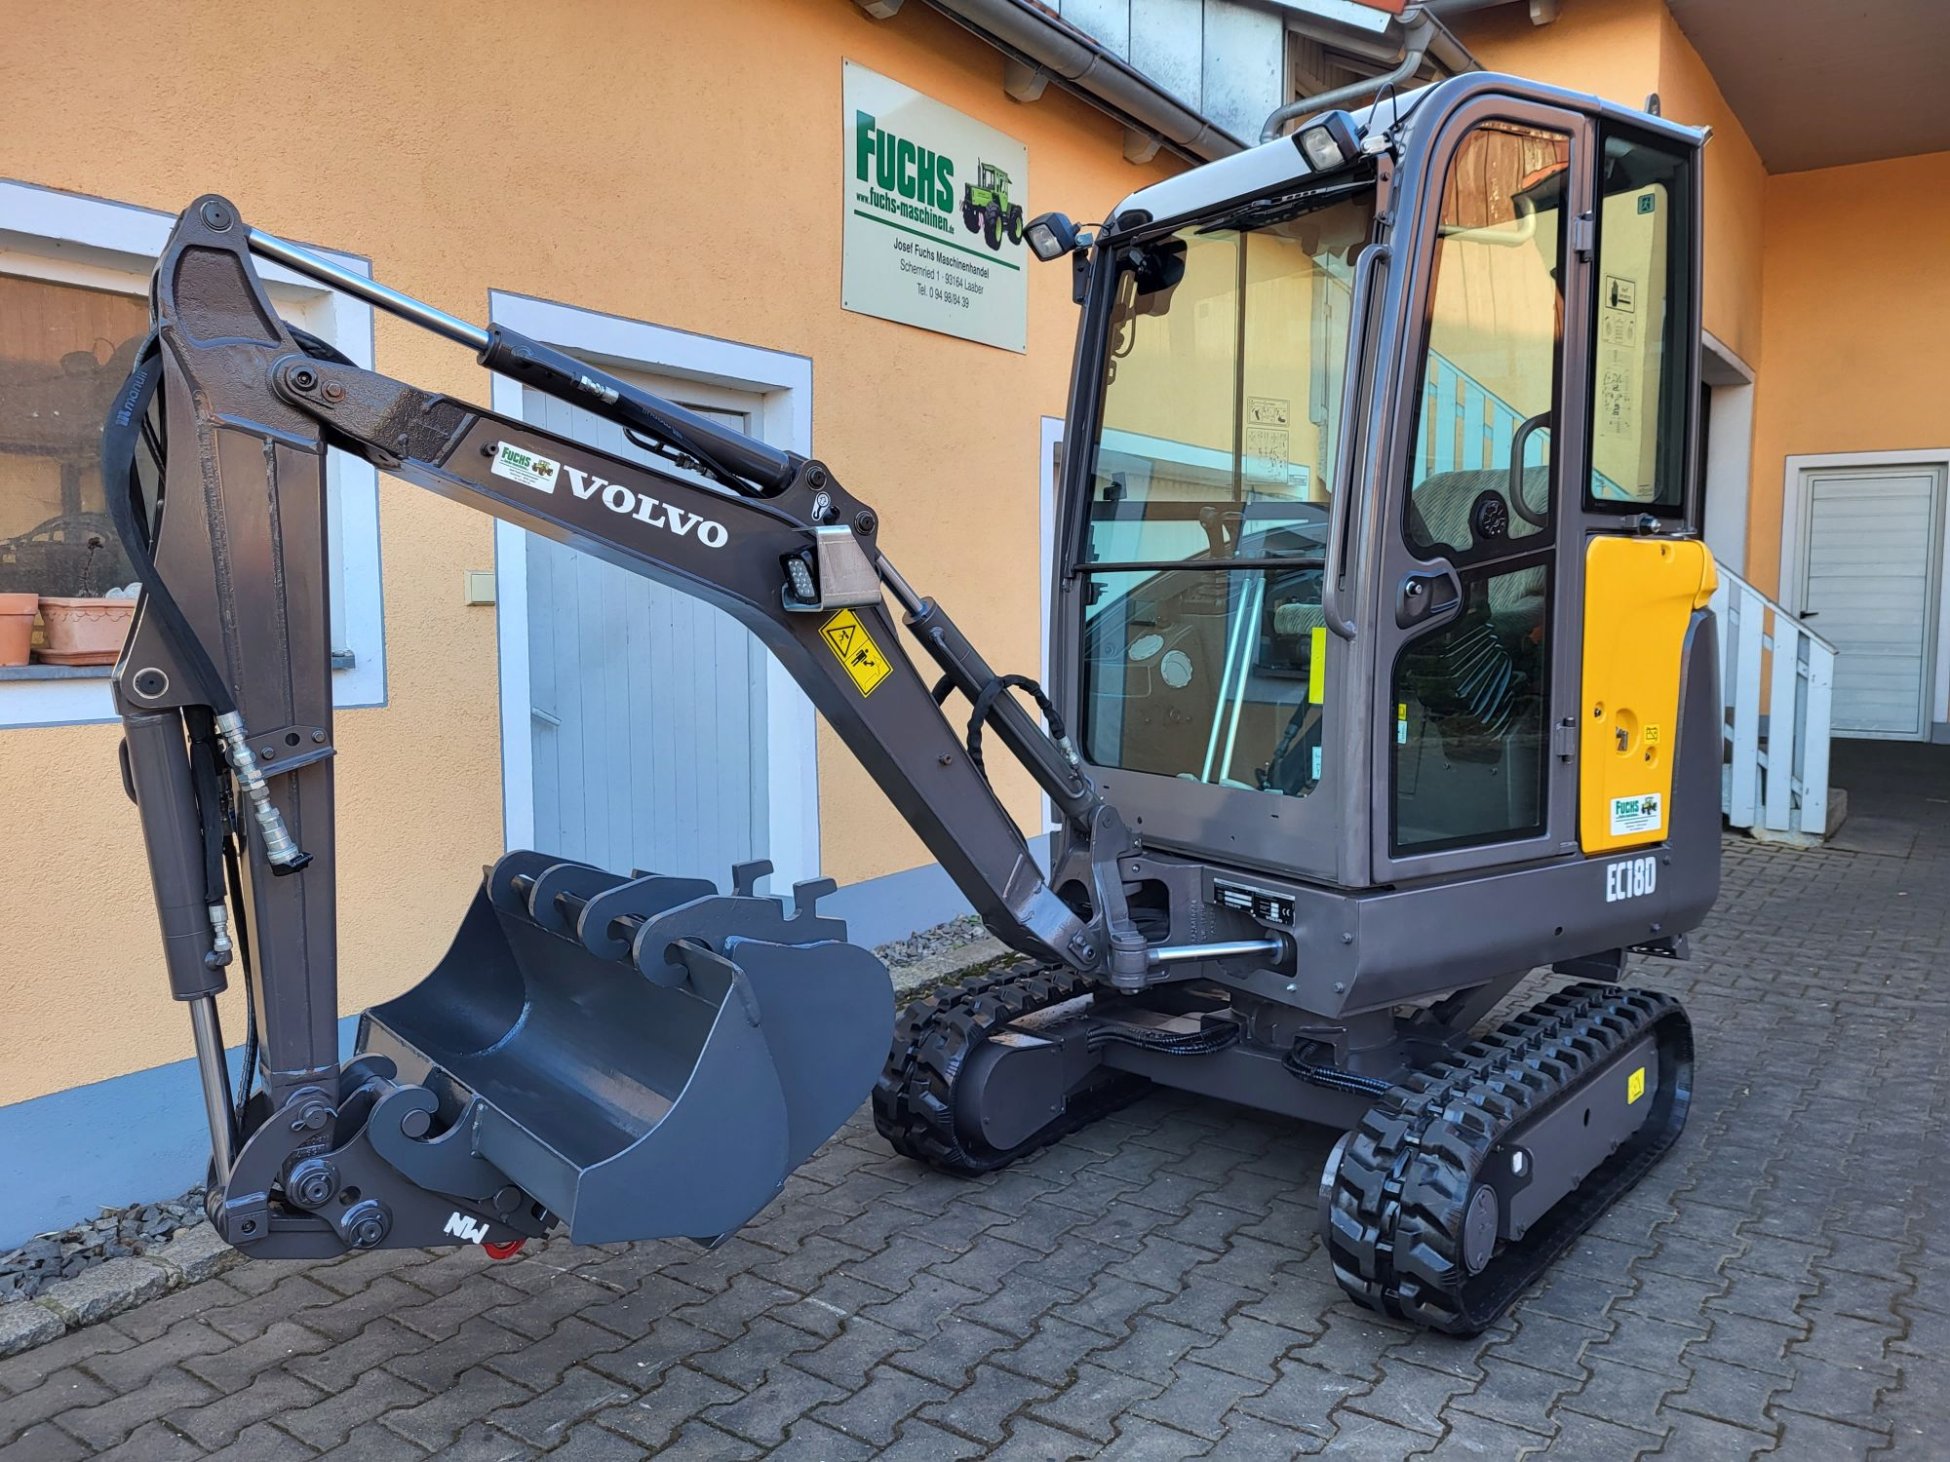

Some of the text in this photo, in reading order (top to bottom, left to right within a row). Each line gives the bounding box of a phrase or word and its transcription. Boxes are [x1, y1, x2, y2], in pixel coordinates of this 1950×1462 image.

[856, 109, 954, 214] FUCHS
[856, 186, 954, 234] www.fuchs-maschinen.de
[893, 237, 990, 279] Josef Fuchs Maschinenhandel
[917, 282, 928, 296] Tel.
[964, 279, 984, 295] Laaber
[501, 446, 532, 467] FUCHS
[563, 465, 729, 548] VOLVO
[1615, 800, 1639, 815] FUCHS
[1606, 856, 1657, 903] EC18D
